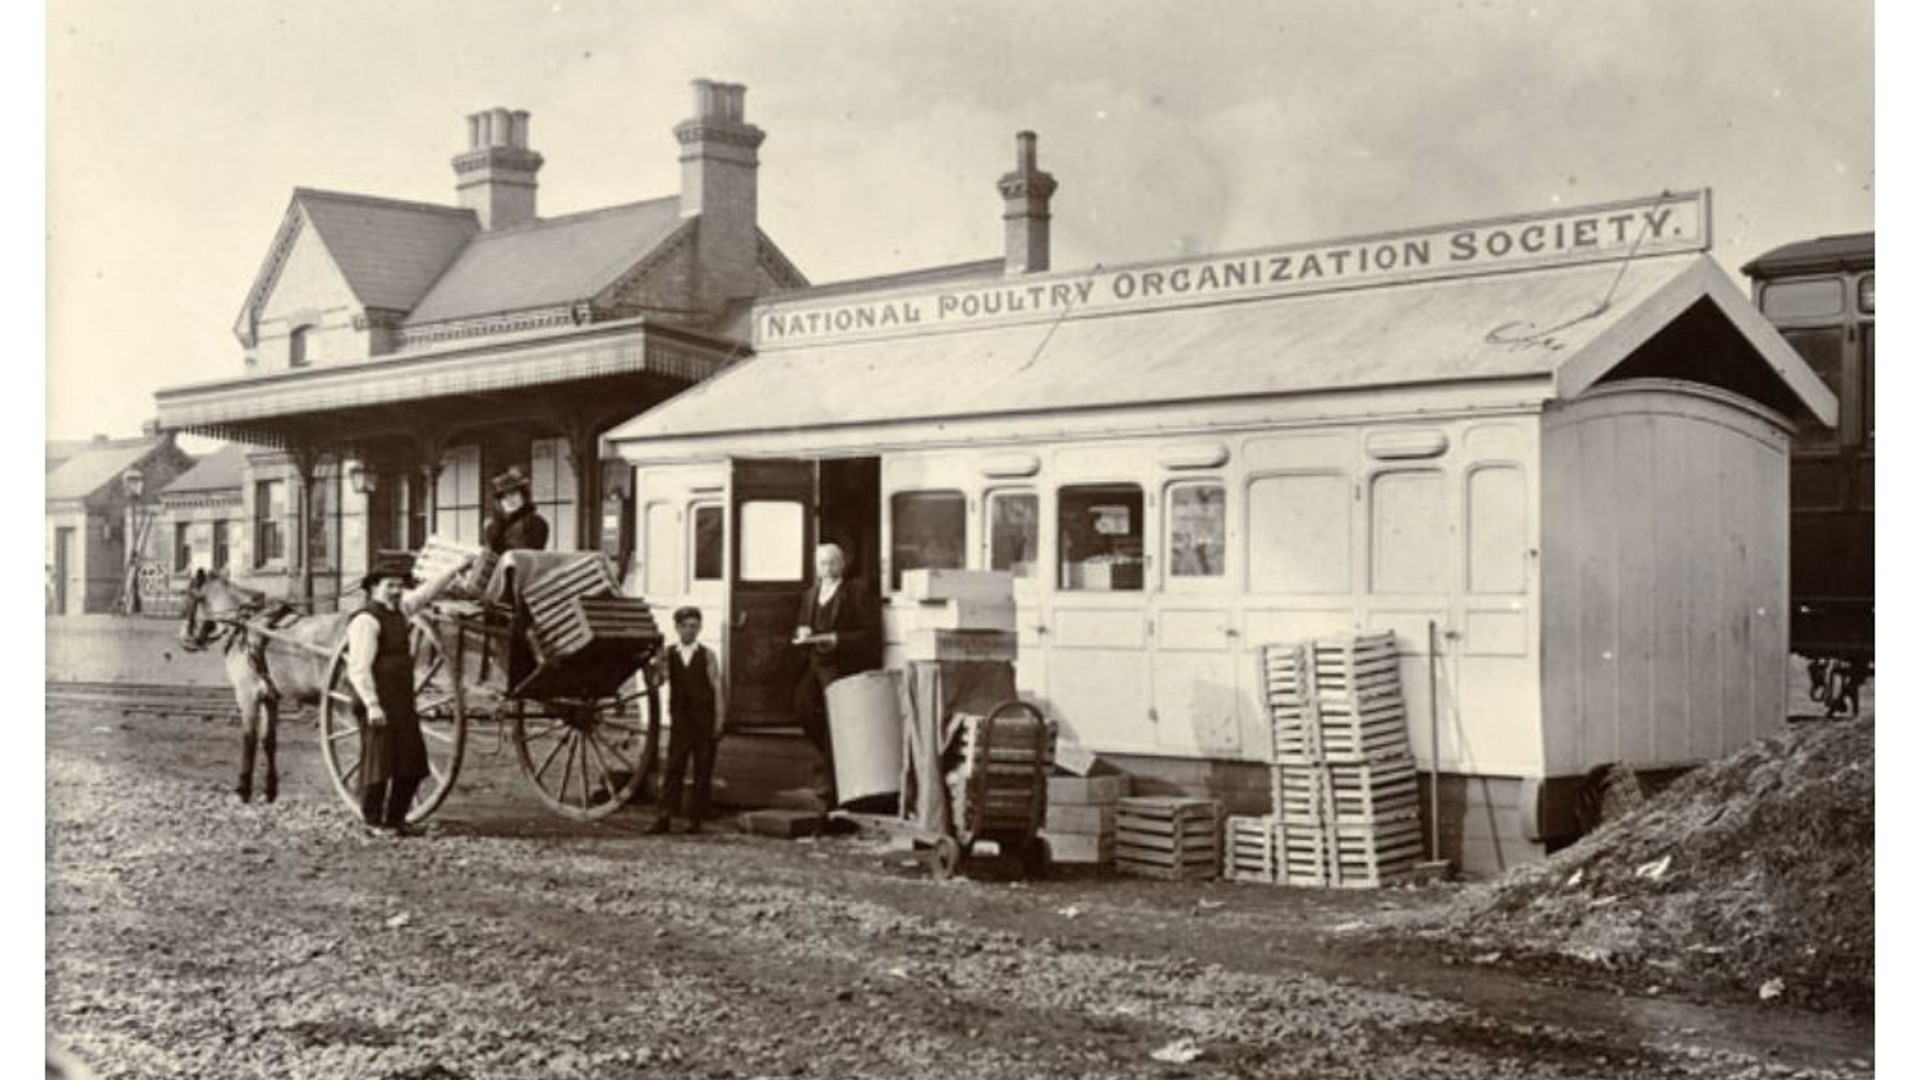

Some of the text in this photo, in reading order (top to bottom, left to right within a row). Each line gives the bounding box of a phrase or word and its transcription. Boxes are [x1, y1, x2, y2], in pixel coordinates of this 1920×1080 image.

[769, 209, 1682, 339] NATIONAL POULTRY ORGANIZATION SOCIETY.
